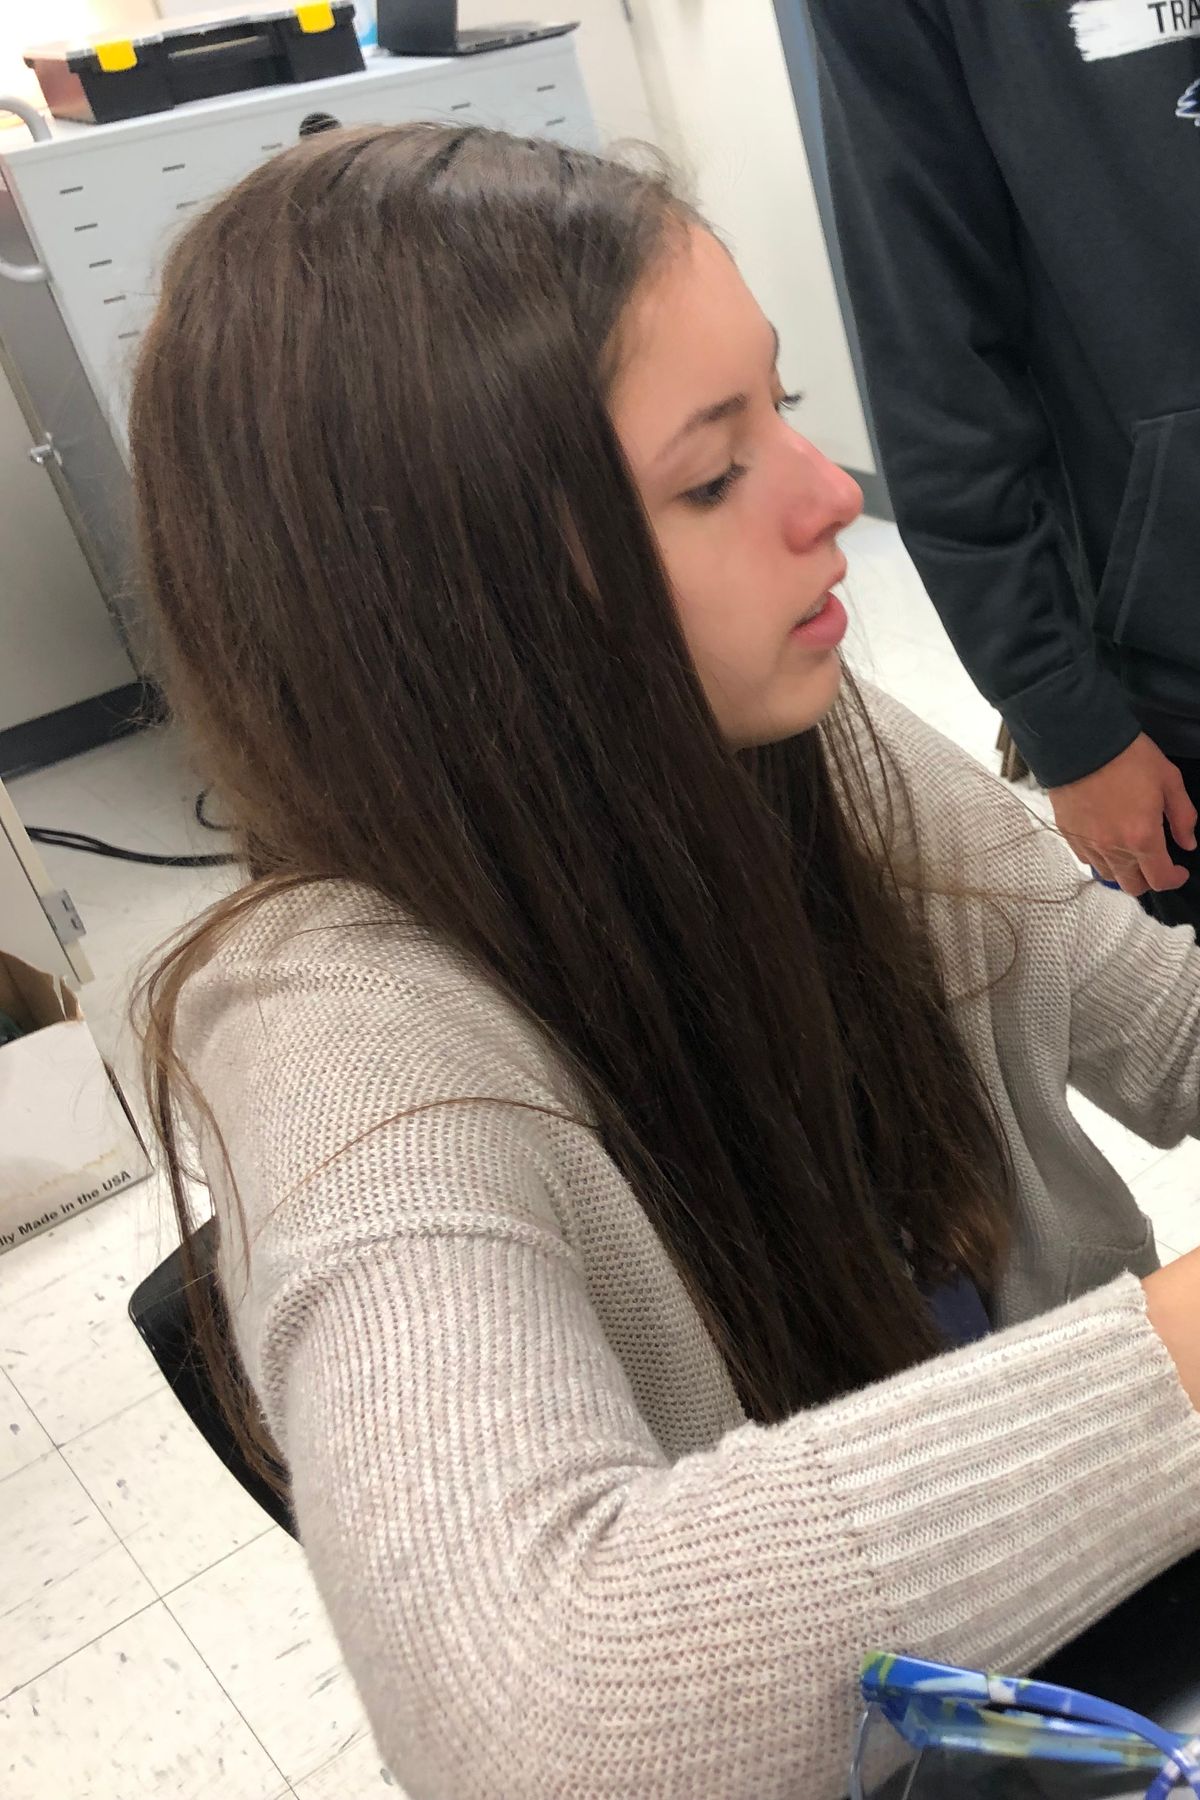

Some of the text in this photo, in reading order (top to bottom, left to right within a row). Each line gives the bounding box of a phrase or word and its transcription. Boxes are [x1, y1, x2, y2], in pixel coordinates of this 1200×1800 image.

[18, 1211, 58, 1235] Made
[60, 1201, 75, 1214] in
[77, 1189, 100, 1205] the
[102, 1170, 131, 1192] USA
